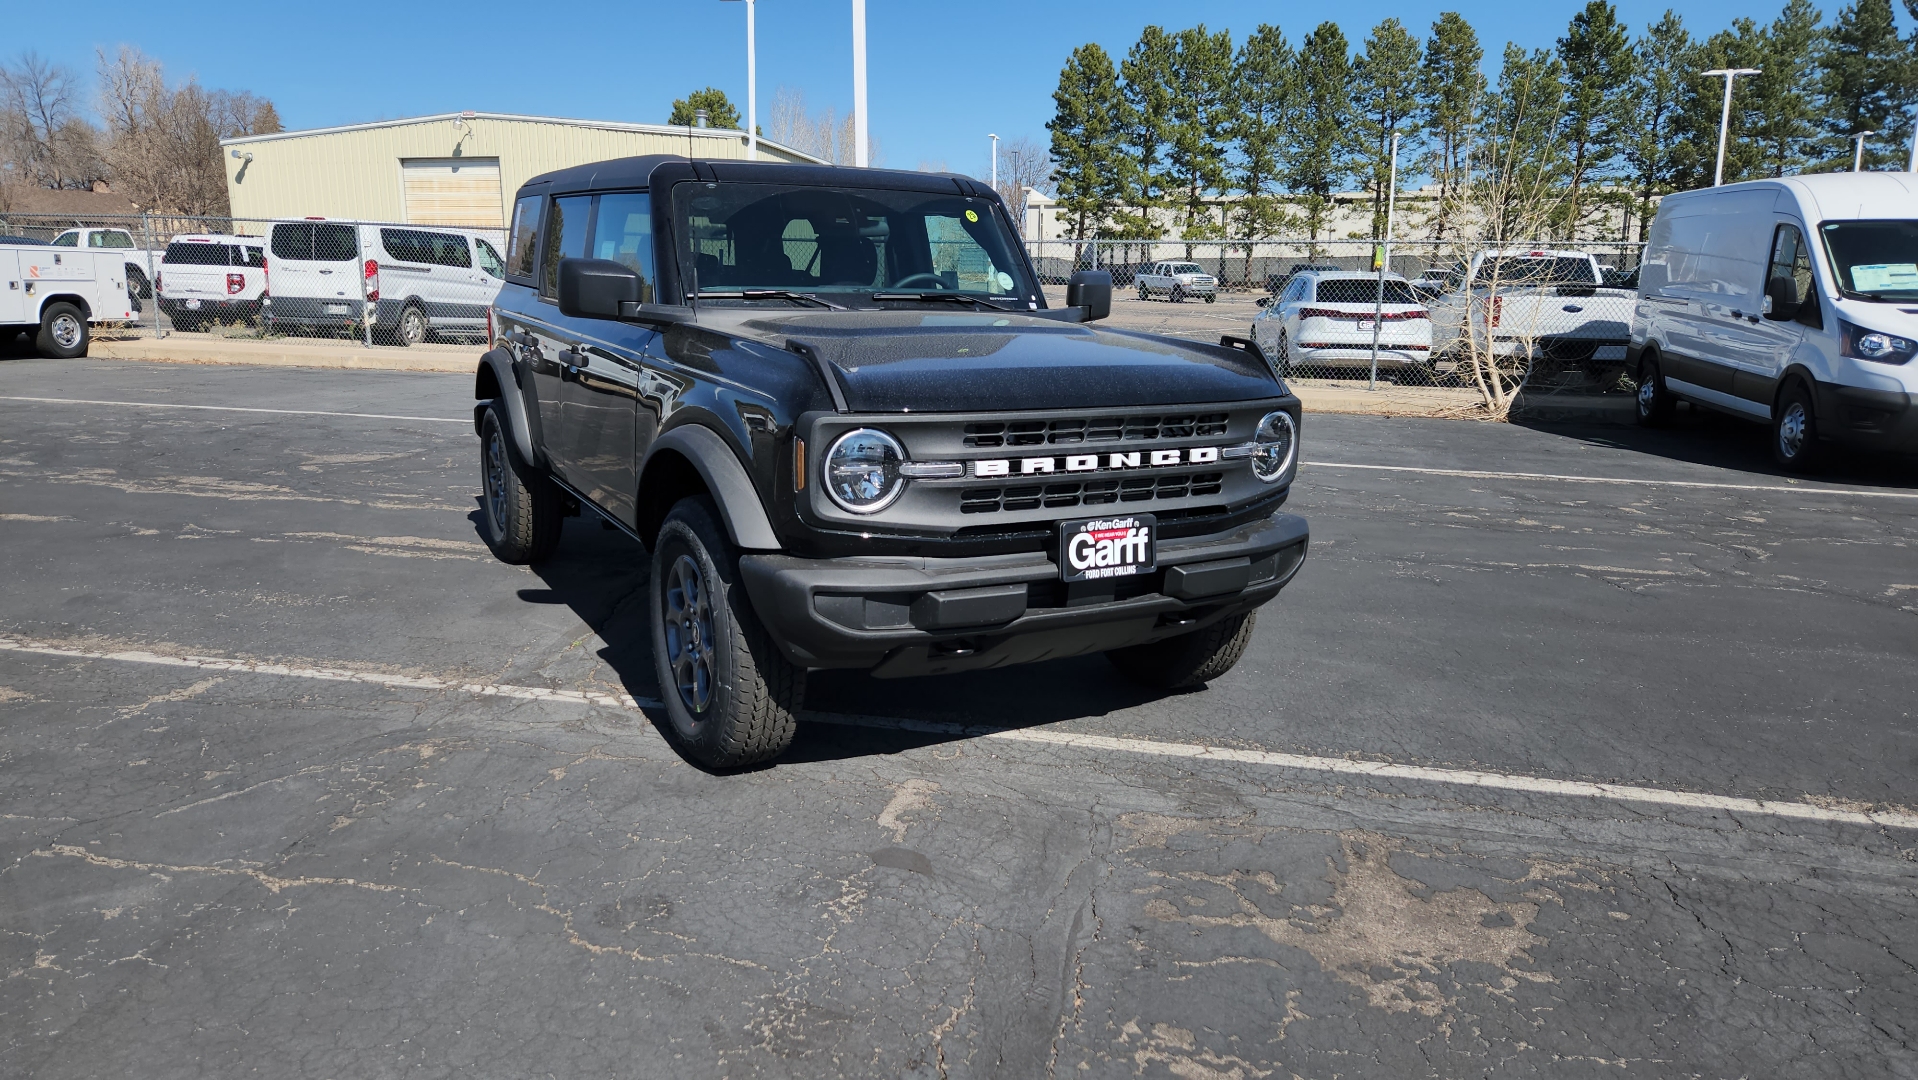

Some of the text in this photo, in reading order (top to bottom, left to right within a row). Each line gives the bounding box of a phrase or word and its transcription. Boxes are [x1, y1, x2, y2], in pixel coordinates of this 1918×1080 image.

[975, 447, 1218, 477] BRONCO
[1094, 518, 1133, 530] Ken Garff
[1068, 527, 1149, 570] Garff
[1085, 565, 1137, 579] FORD FORT COLLINS
